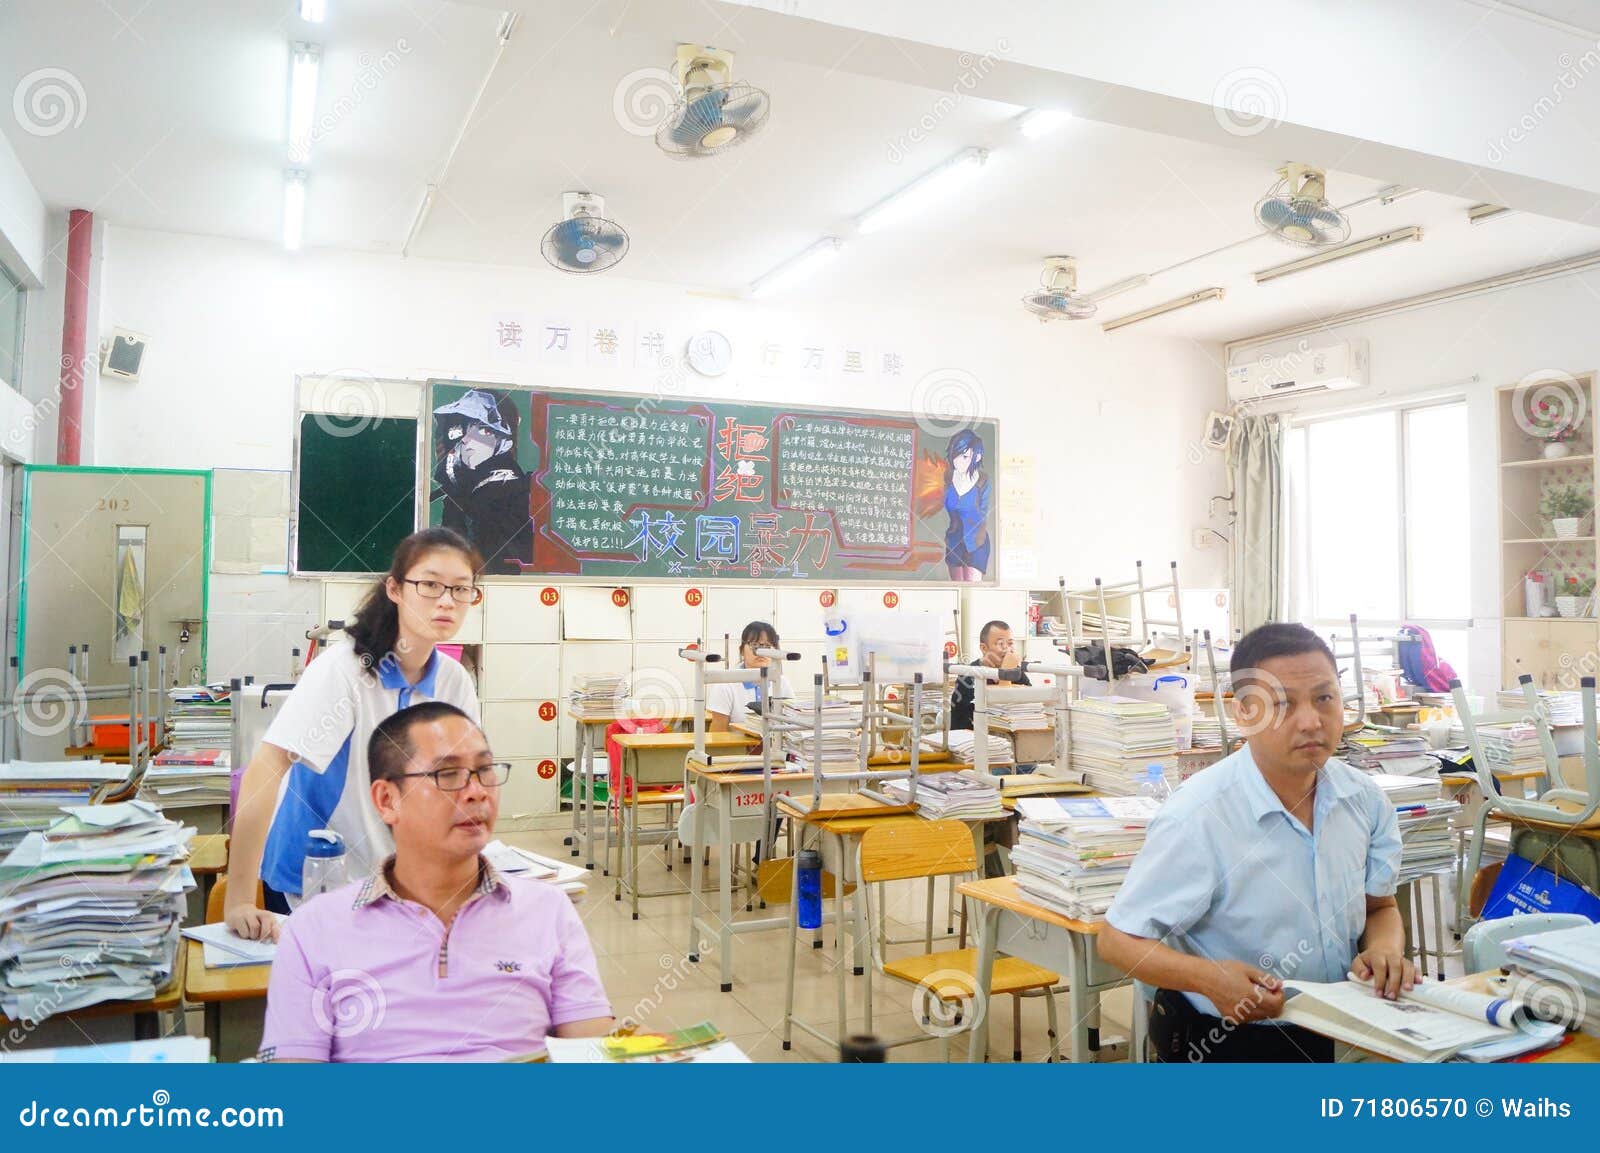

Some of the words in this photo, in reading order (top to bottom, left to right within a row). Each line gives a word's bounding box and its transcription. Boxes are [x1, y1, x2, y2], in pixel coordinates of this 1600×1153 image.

[713, 417, 770, 502] 拒绝
[97, 497, 130, 511] 202
[624, 510, 832, 569] 校园暴力
[542, 592, 557, 602] 03
[613, 594, 628, 604] 04
[687, 592, 702, 603] 05
[821, 594, 833, 604] 07
[885, 594, 897, 605] 08
[541, 706, 555, 717] 31
[540, 764, 554, 775] 45
